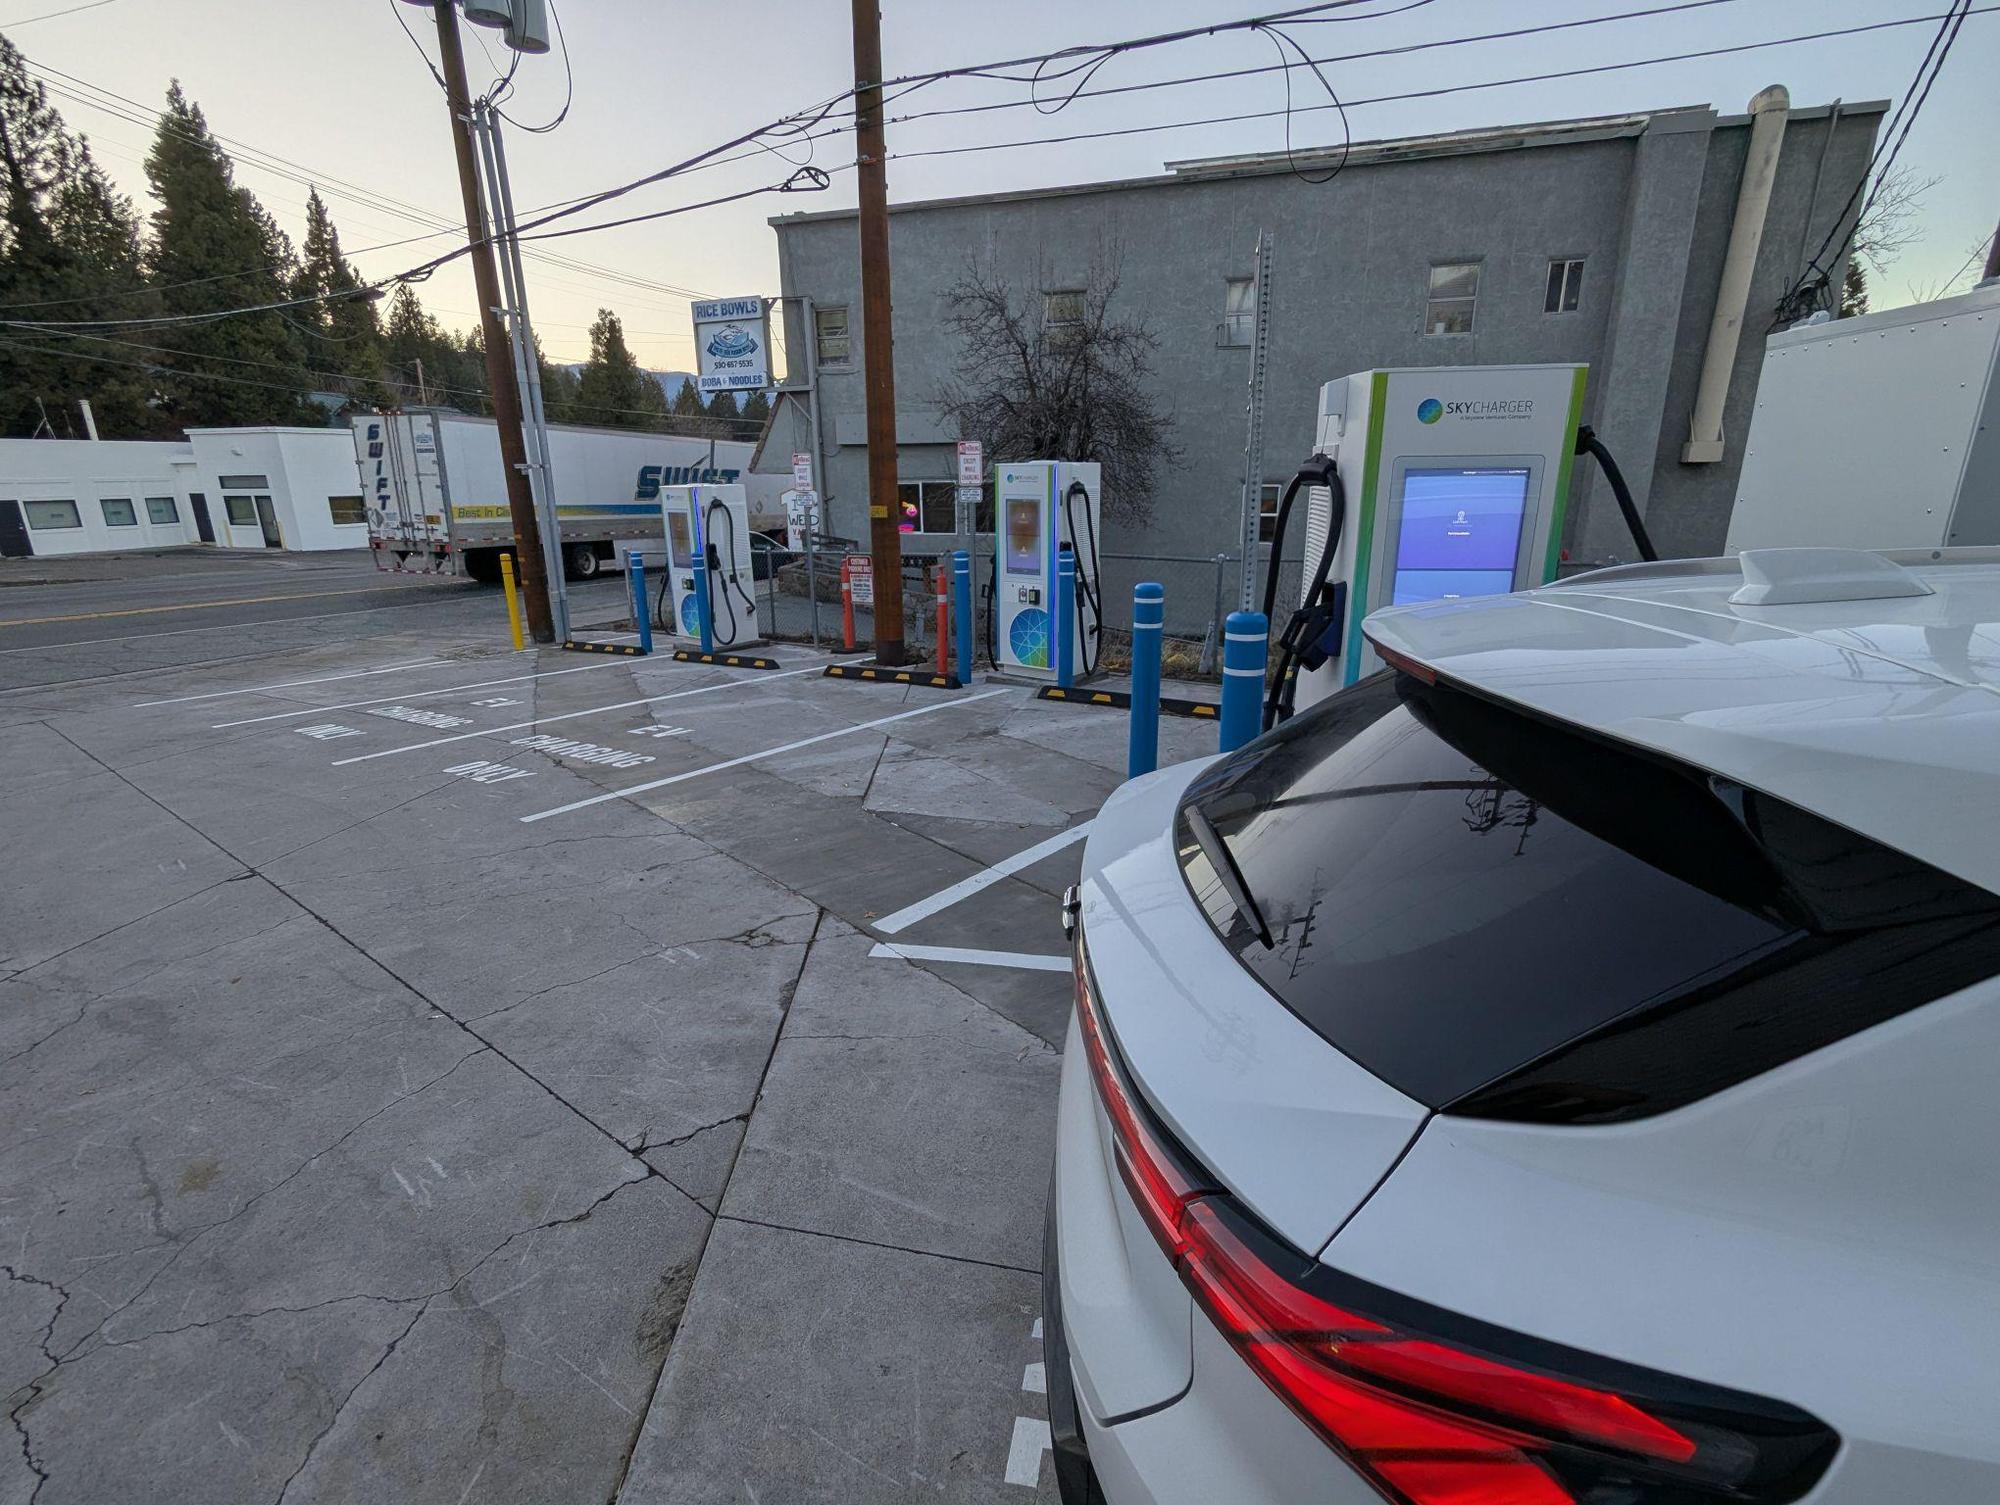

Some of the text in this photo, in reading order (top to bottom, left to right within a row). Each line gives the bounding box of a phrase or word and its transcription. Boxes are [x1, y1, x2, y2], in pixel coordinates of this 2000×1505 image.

[696, 301, 758, 318] RICE BOWLS
[701, 376, 722, 387] BOBA
[729, 375, 763, 385] NOODLES
[1445, 400, 1534, 414] SKYCHARGER
[367, 424, 391, 511] SWIFT
[788, 513, 820, 526] WED
[366, 705, 475, 729] CHARGING
[293, 723, 368, 741] ONLY
[627, 724, 697, 738] EV
[509, 734, 657, 769] CHARGING
[442, 760, 539, 784] ONLY
